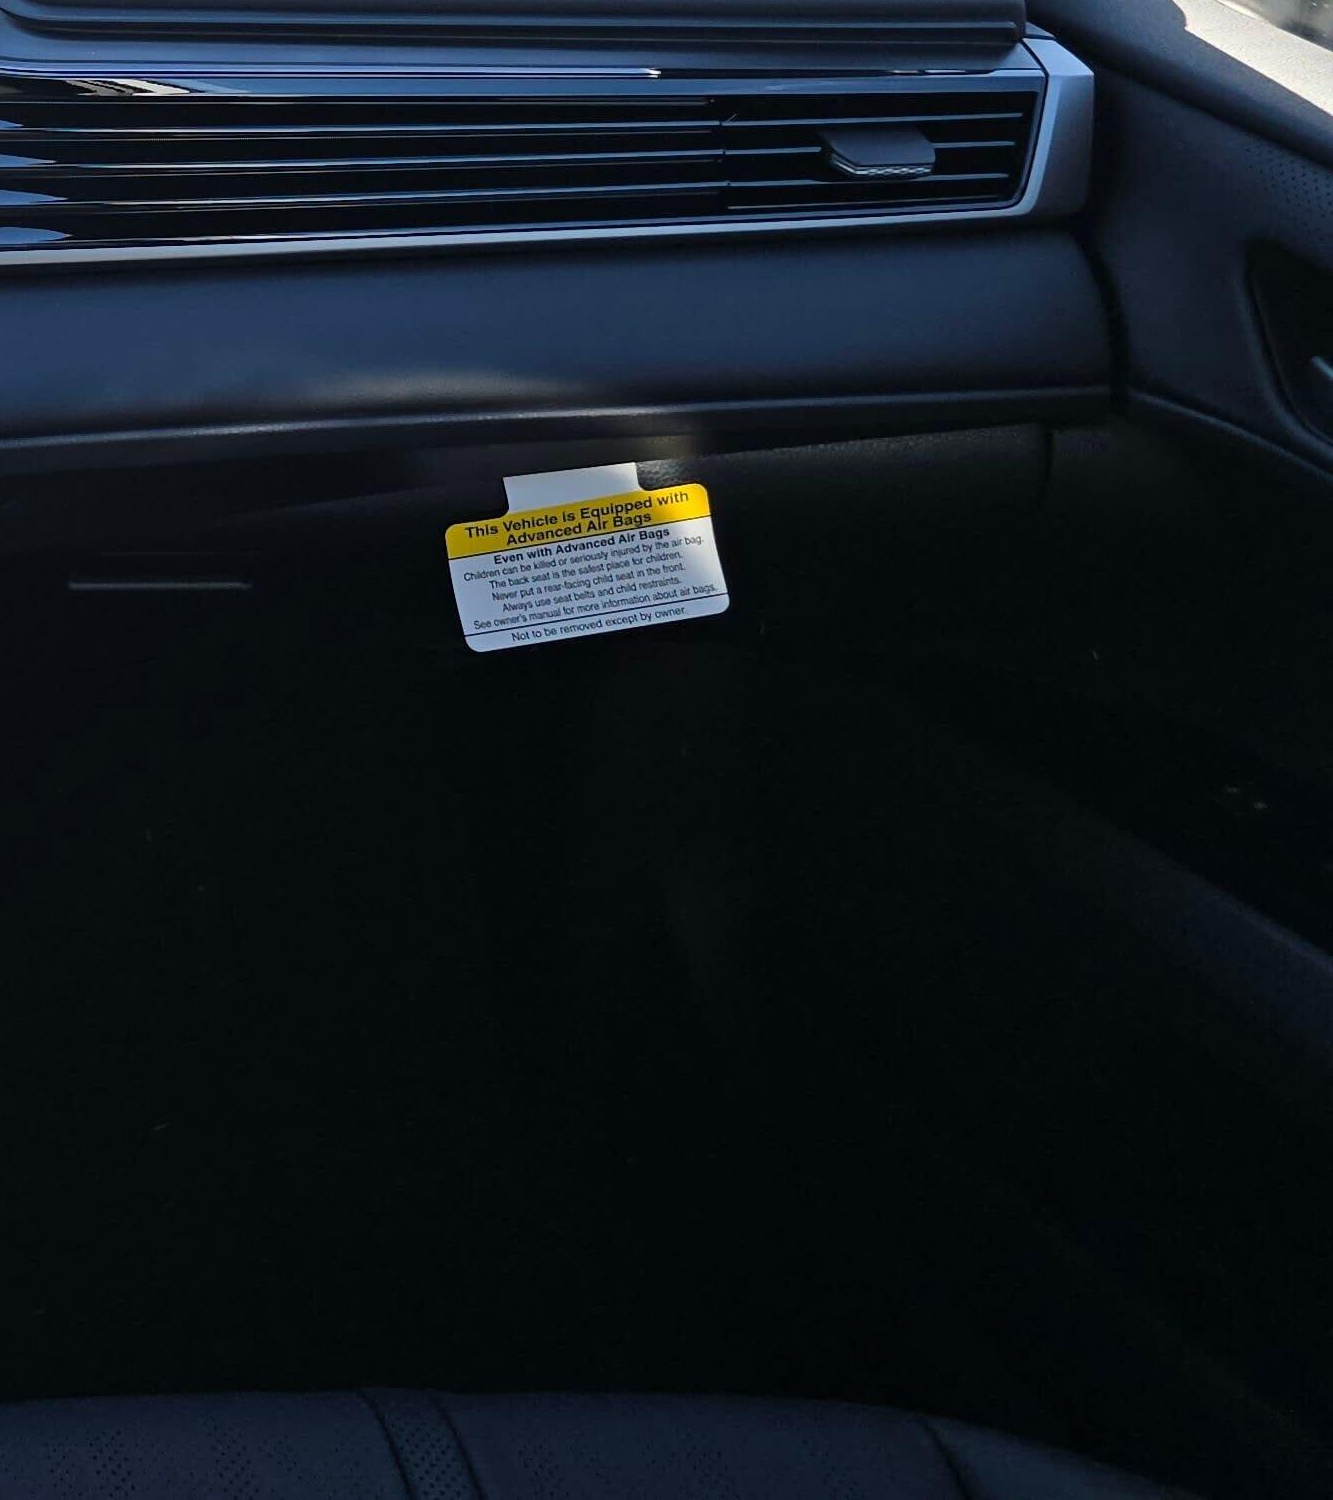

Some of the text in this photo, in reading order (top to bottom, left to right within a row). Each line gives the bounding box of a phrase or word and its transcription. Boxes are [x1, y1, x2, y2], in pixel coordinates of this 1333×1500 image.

[464, 491, 689, 539] This Vehicle is Equipped with
[505, 510, 652, 545] Advanced Air Bags
[463, 567, 500, 582] Children
[502, 566, 518, 575] can
[519, 562, 531, 572] be
[533, 558, 556, 570] killed
[558, 557, 567, 566] or
[569, 549, 608, 566] seriously
[610, 544, 640, 559] injured
[641, 542, 653, 554] by
[654, 540, 670, 550] the
[671, 537, 683, 547] air
[493, 527, 670, 565] Even with Advanced Air Bags
[489, 579, 506, 589] The
[508, 575, 529, 586] back
[531, 572, 550, 582] seat
[552, 570, 560, 579] is
[561, 567, 576, 578] the
[578, 562, 604, 575] safest
[606, 558, 630, 572] place
[631, 556, 643, 566] for
[492, 589, 518, 601] Never
[519, 587, 534, 599] put
[592, 573, 613, 585] child
[615, 570, 634, 581] seat
[636, 568, 645, 577] in
[645, 565, 661, 576] the
[473, 619, 491, 629] See
[493, 612, 527, 626] owner's
[528, 607, 561, 620] manual
[562, 604, 574, 615] for
[576, 602, 599, 613] more
[601, 592, 650, 609] information
[651, 588, 677, 600] about
[679, 586, 691, 596] air
[502, 599, 533, 614] Always
[535, 598, 551, 607] use
[552, 593, 572, 604] seat
[573, 589, 595, 600] belts
[597, 585, 614, 596] and
[615, 582, 636, 593] child
[511, 630, 530, 642] Not
[531, 629, 542, 638] to
[544, 625, 557, 636] be
[559, 618, 602, 634] removed
[605, 613, 638, 628] except
[639, 610, 652, 622] by
